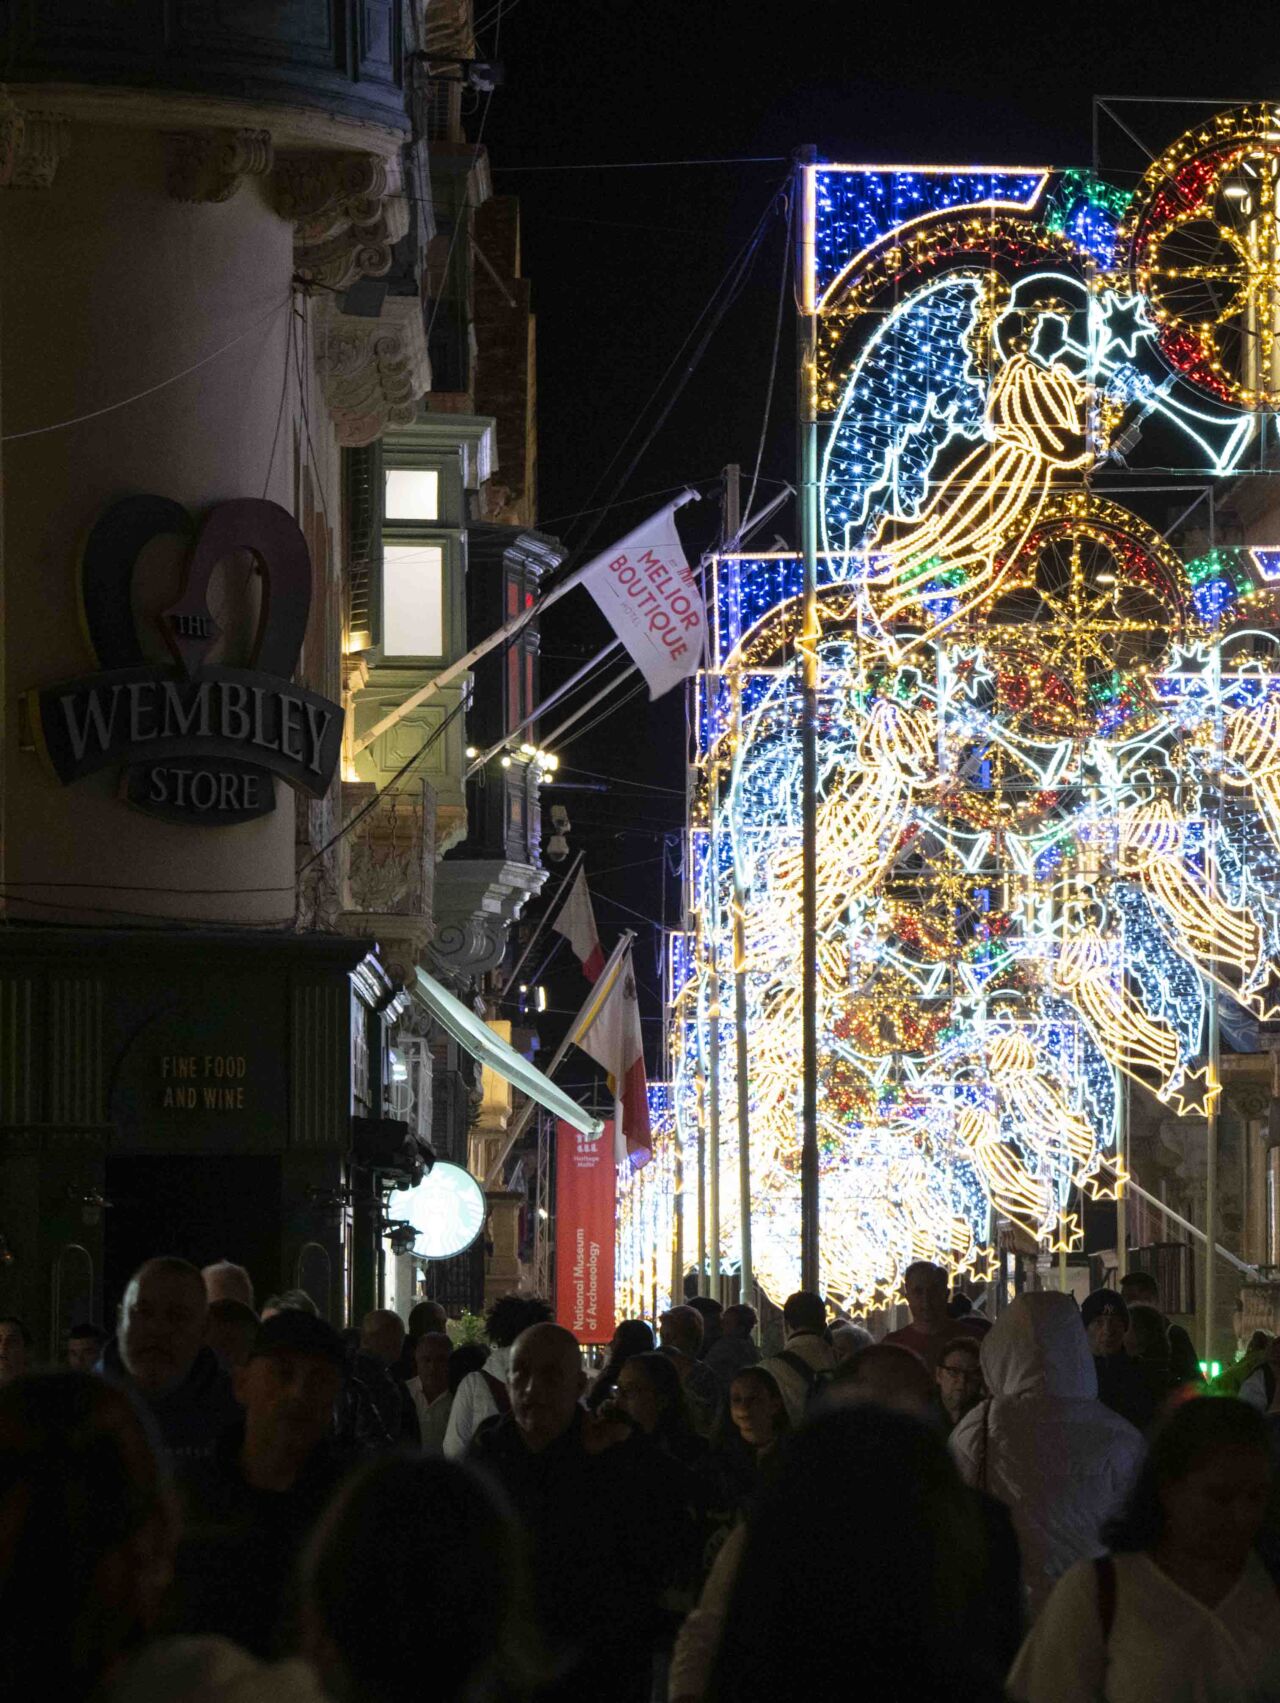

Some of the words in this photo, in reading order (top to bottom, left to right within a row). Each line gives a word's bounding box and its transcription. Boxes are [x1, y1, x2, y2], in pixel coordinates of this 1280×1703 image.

[609, 554, 689, 661] BOUTIQUE
[637, 550, 700, 631] MELIOR
[59, 681, 332, 775] WEMBLEY
[150, 767, 260, 809] STORE
[161, 1056, 198, 1078] FINE
[204, 1056, 246, 1078] FOOD
[163, 1087, 197, 1109] AND
[204, 1087, 245, 1109] WINE
[573, 1228, 585, 1278] Museum
[586, 1241, 600, 1316] Archaeology
[573, 1280, 585, 1331] National
[586, 1317, 598, 1331] of
